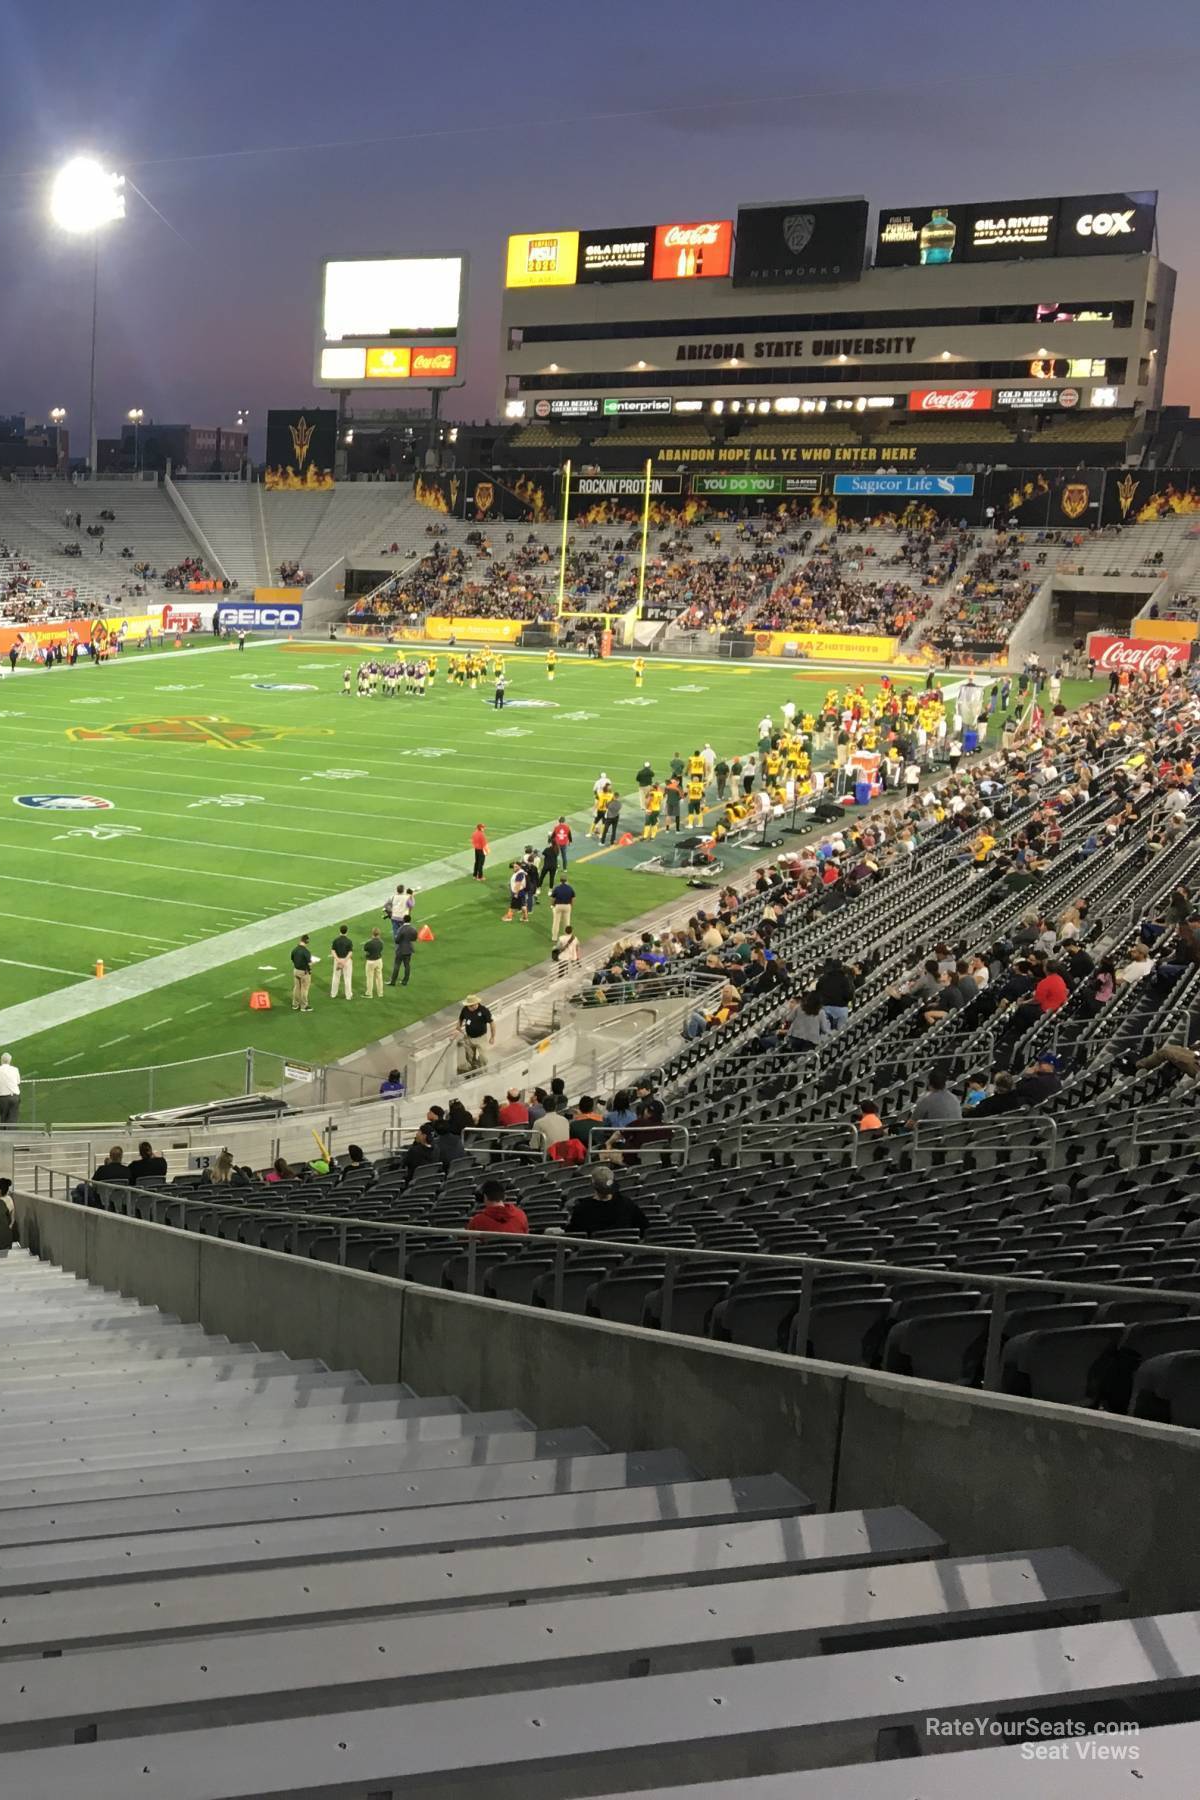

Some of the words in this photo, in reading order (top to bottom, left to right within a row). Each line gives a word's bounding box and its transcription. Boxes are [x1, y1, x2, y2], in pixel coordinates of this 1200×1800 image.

[886, 222, 914, 233] POWER
[975, 219, 1007, 231] GILA
[1008, 216, 1048, 229] RIVER
[1076, 210, 1136, 237] COX
[585, 245, 611, 255] GILA
[612, 242, 646, 254] RIVER
[750, 265, 841, 278] NETWORKS
[676, 342, 745, 360] ARIZONA
[754, 340, 803, 358] STATE
[812, 336, 917, 356] UNIVERSITY
[921, 391, 978, 409] Coca-Cola
[1023, 390, 1051, 398] BEERS
[605, 401, 669, 413] enterprise
[657, 449, 714, 461] ABANDON
[719, 448, 750, 460] HOPE
[754, 448, 776, 460] ALL
[782, 448, 797, 460] YE
[801, 448, 831, 460] WHO
[835, 448, 877, 460] ENTER
[881, 447, 918, 460] HERE
[704, 479, 727, 490] YOU
[730, 479, 748, 489] DO
[750, 479, 775, 490] YOU
[852, 477, 902, 493] Sagicor
[906, 477, 933, 490] Life
[219, 609, 300, 625] GEICO
[257, 994, 267, 1006] G
[195, 1157, 210, 1169] 13
